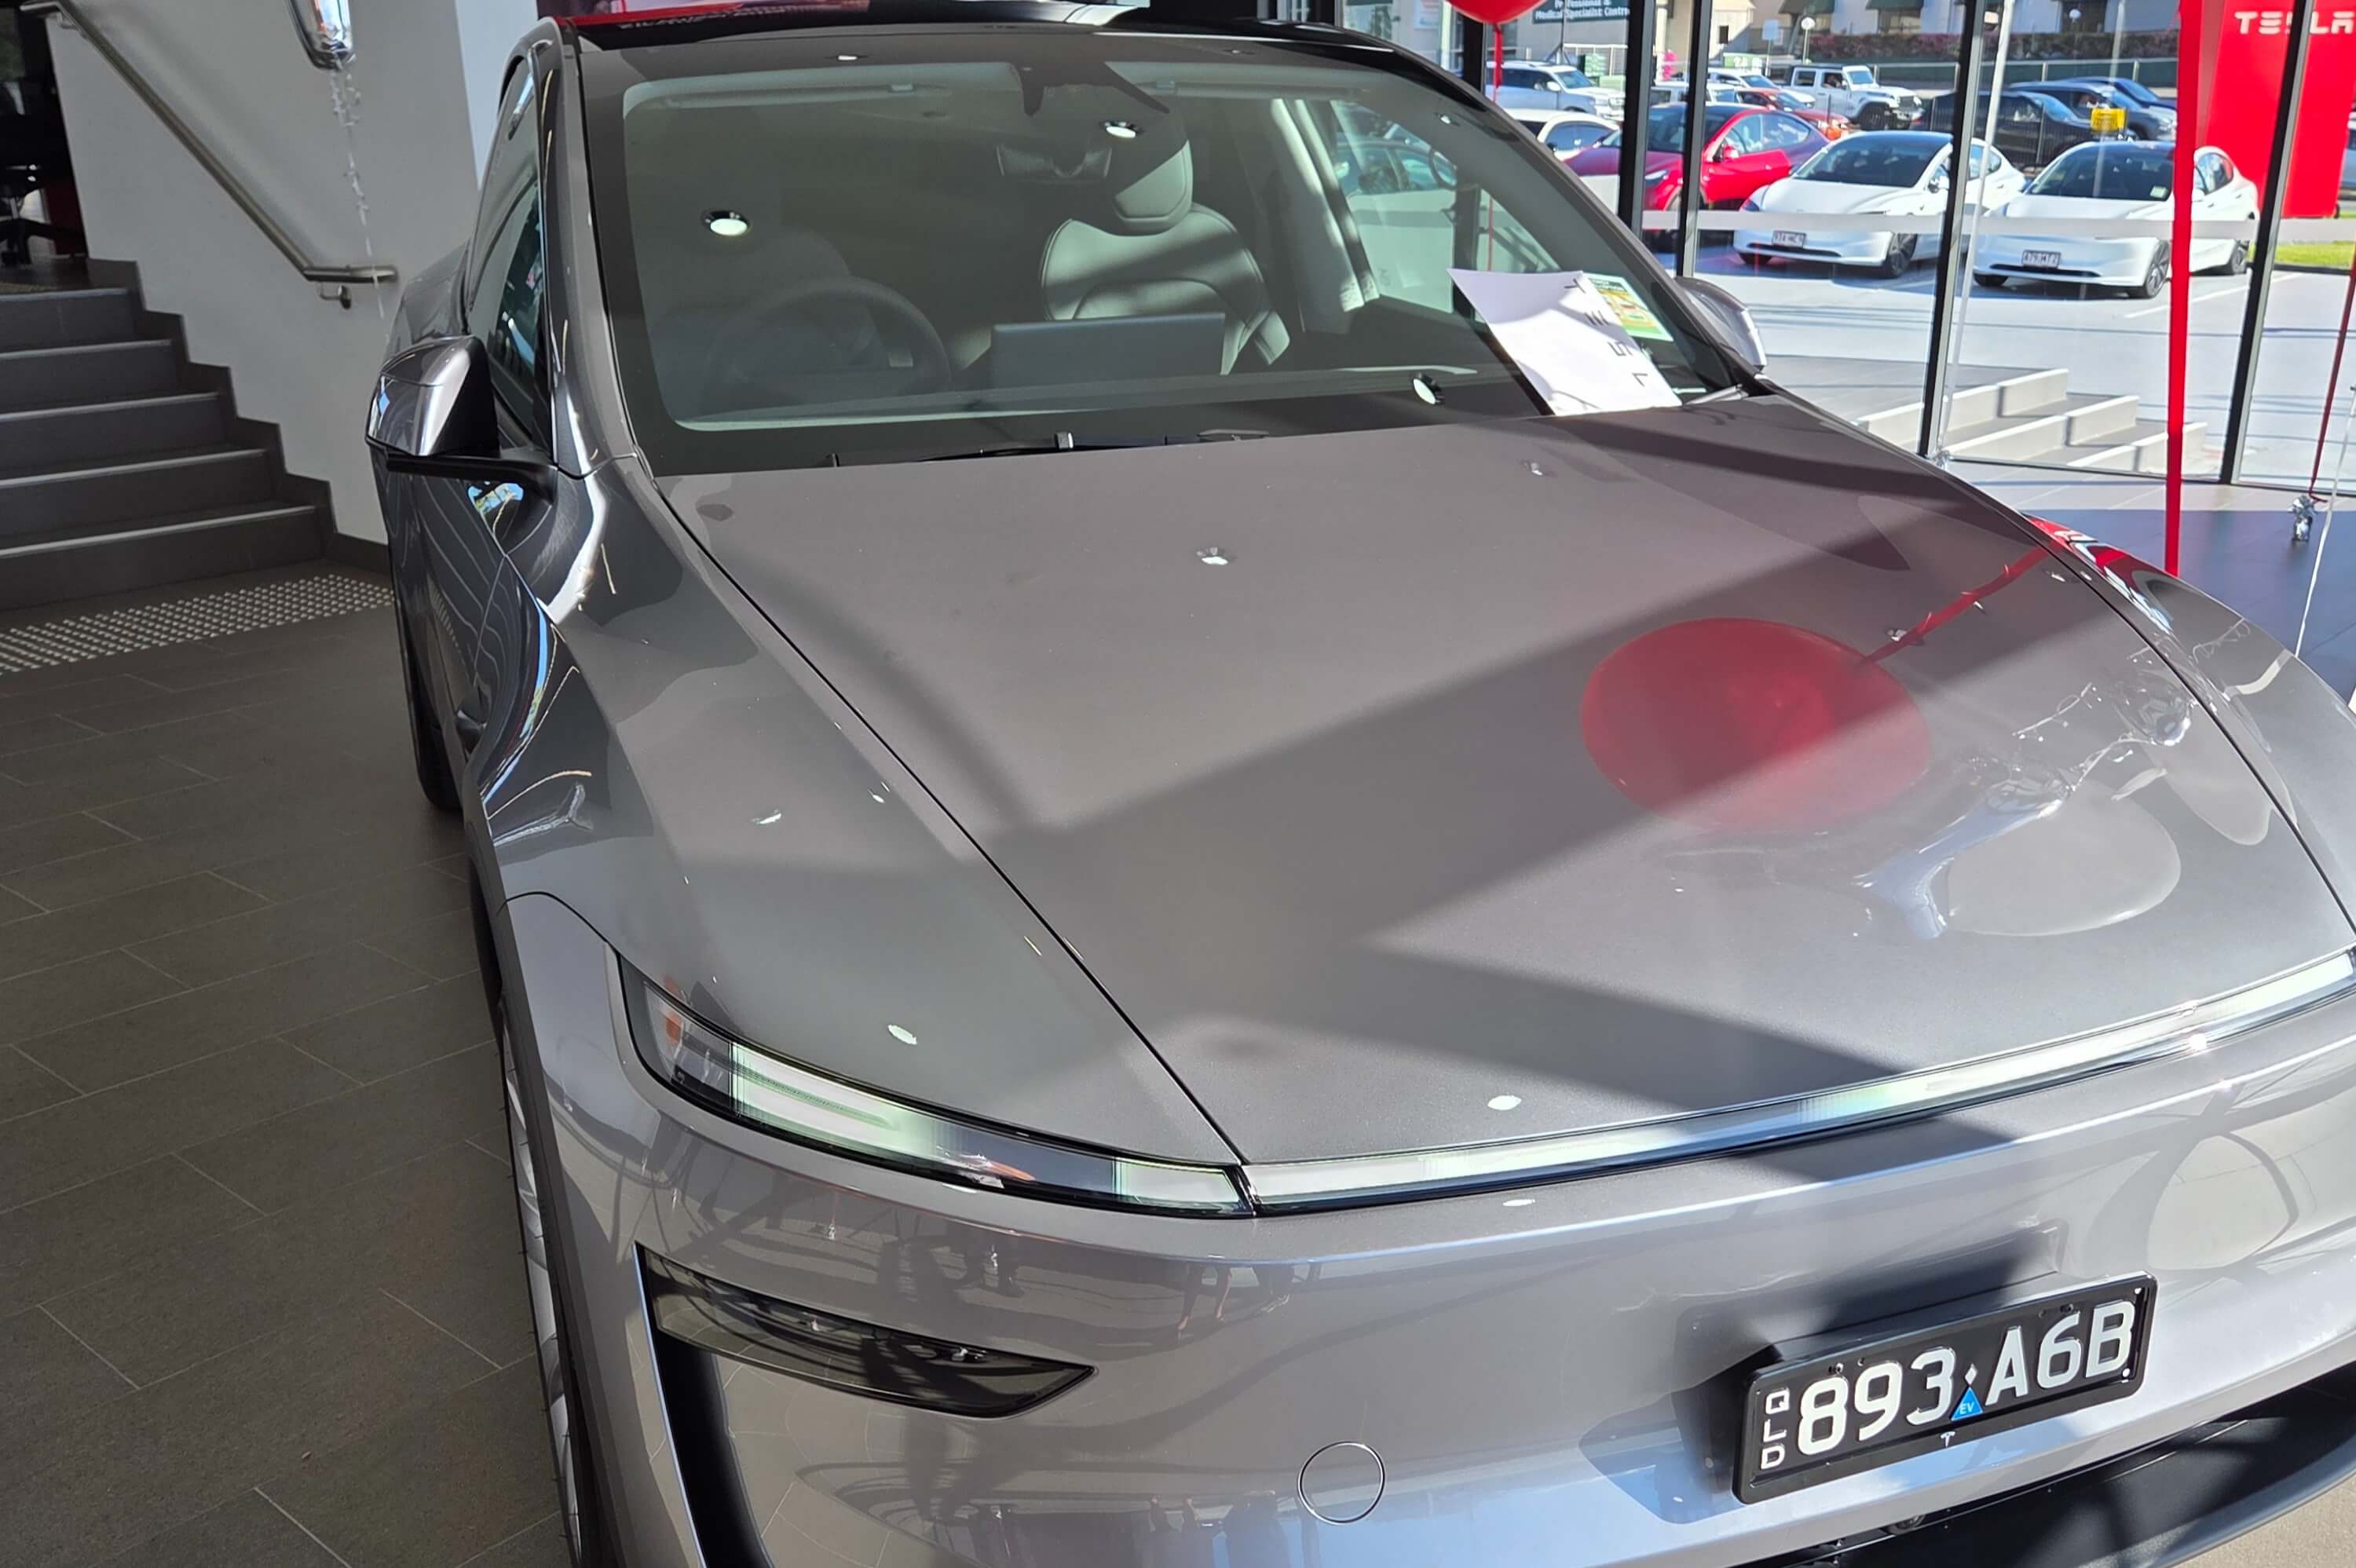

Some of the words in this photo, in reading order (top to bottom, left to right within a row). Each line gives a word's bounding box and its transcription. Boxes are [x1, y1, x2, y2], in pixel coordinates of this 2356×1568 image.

[1798, 1347, 1955, 1456] 893
[1985, 1301, 2135, 1405] A6B
[1959, 1401, 1974, 1415] EV
[1761, 1387, 1790, 1470] QLD
